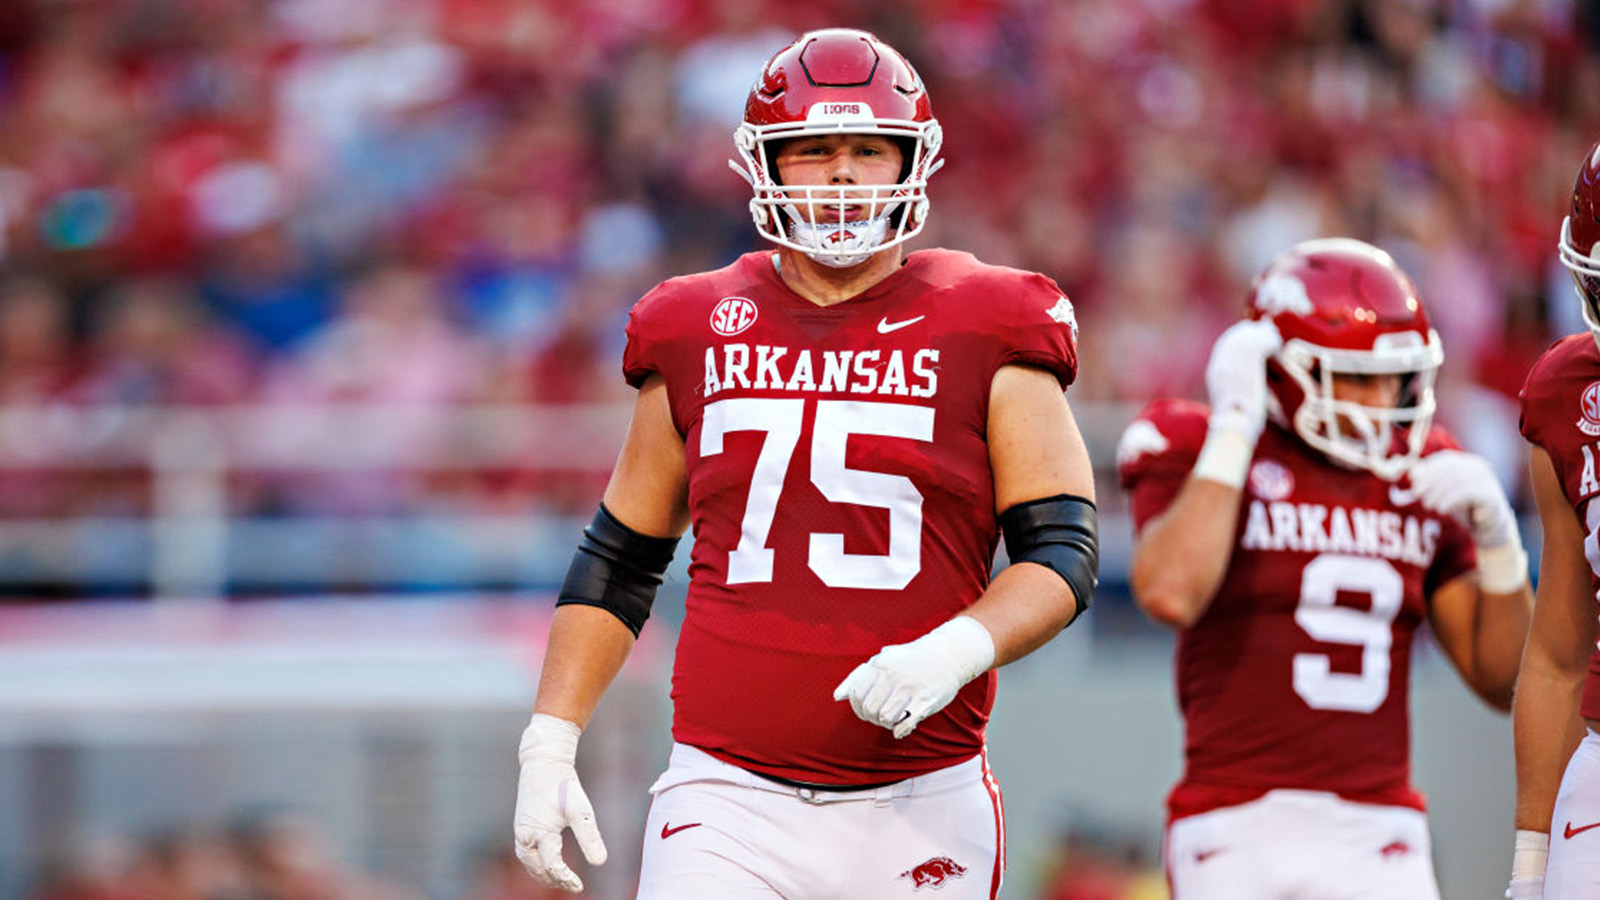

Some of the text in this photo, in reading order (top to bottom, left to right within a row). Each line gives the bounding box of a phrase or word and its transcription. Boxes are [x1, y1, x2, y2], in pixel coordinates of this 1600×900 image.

[715, 300, 753, 332] SEC
[704, 343, 939, 398] ARKANSAS
[700, 398, 936, 590] 75
[1242, 499, 1442, 569] ARKANSAS
[1293, 553, 1404, 714] 9
